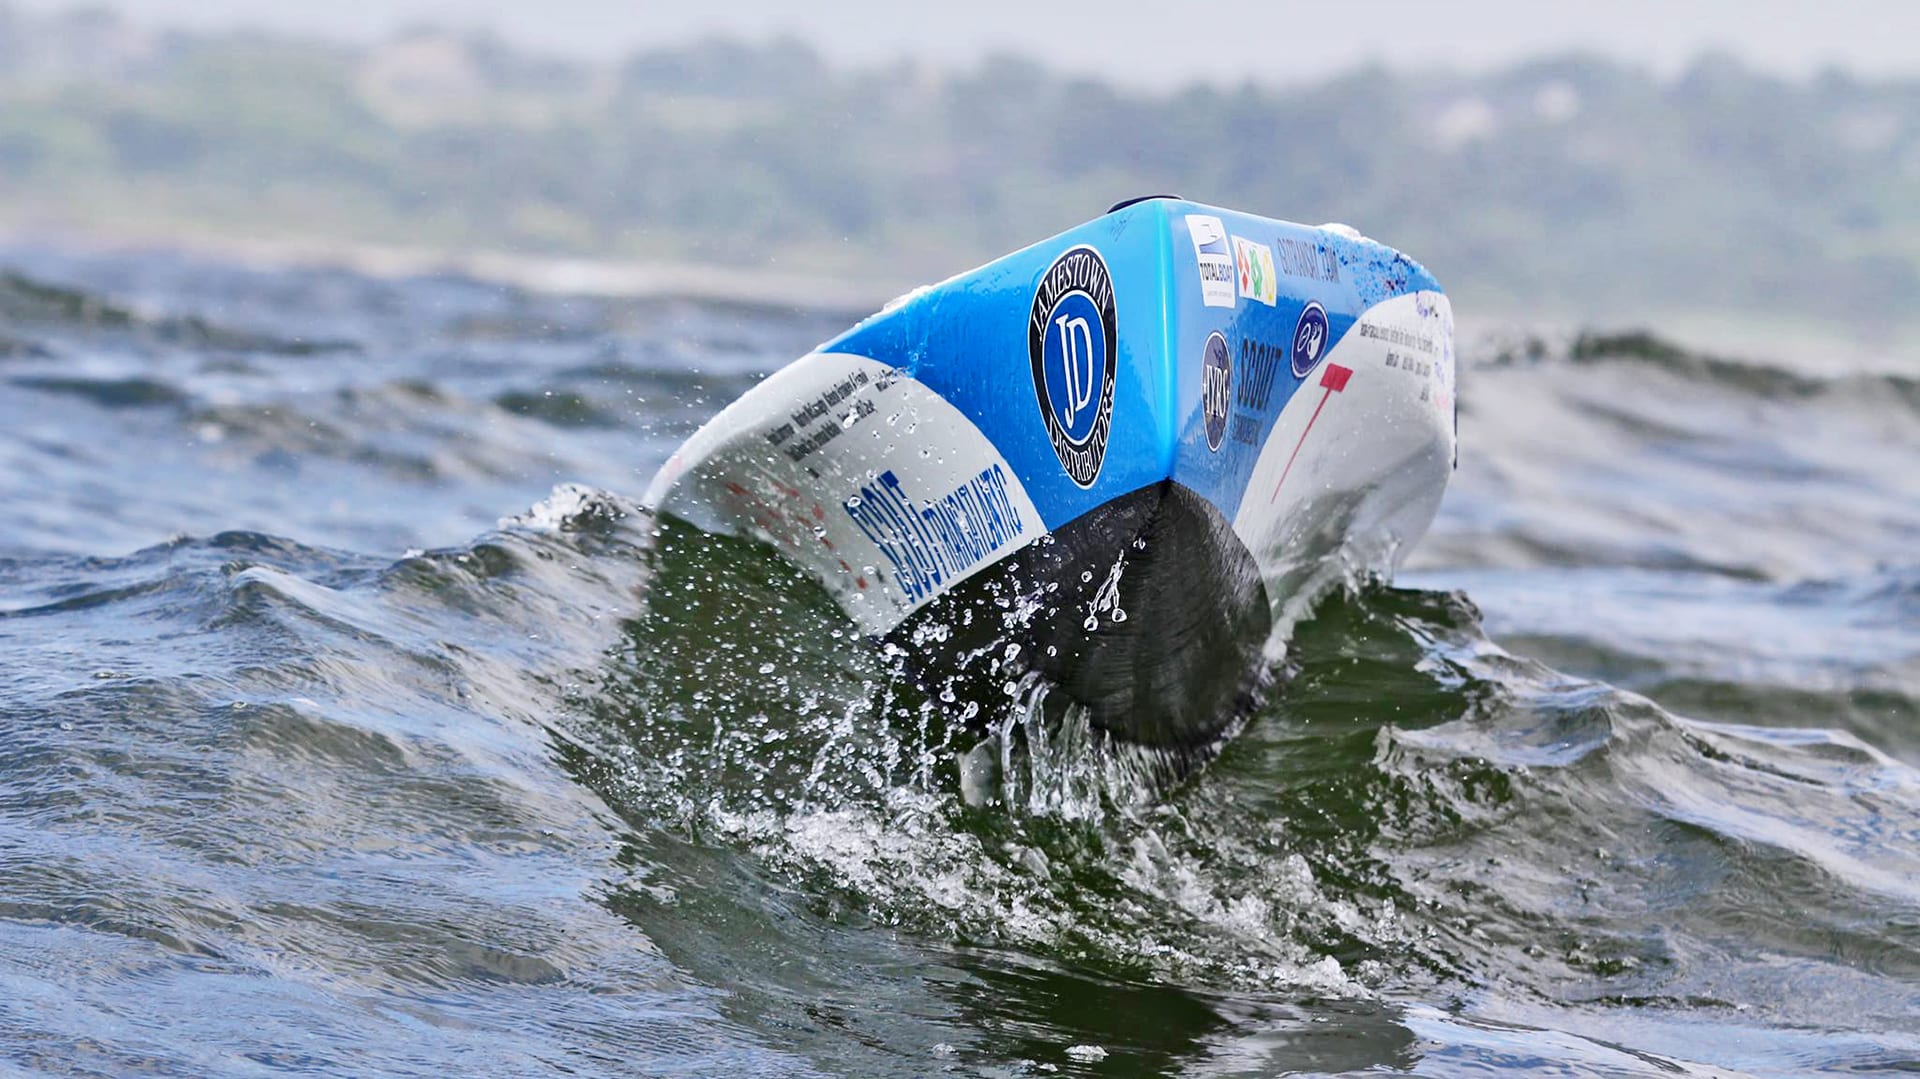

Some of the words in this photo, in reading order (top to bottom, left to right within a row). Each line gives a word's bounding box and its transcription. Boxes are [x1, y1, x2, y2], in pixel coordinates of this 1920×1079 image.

[1032, 254, 1110, 342] JAMESTOWN
[1200, 262, 1233, 283] TOTALBOAT
[1055, 313, 1093, 430] JD
[1237, 338, 1282, 412] SCOUT
[1049, 372, 1115, 484] DISTRIBUTORS
[843, 470, 941, 604] SCOUT
[922, 463, 1024, 580] TRANSATLANTIC
